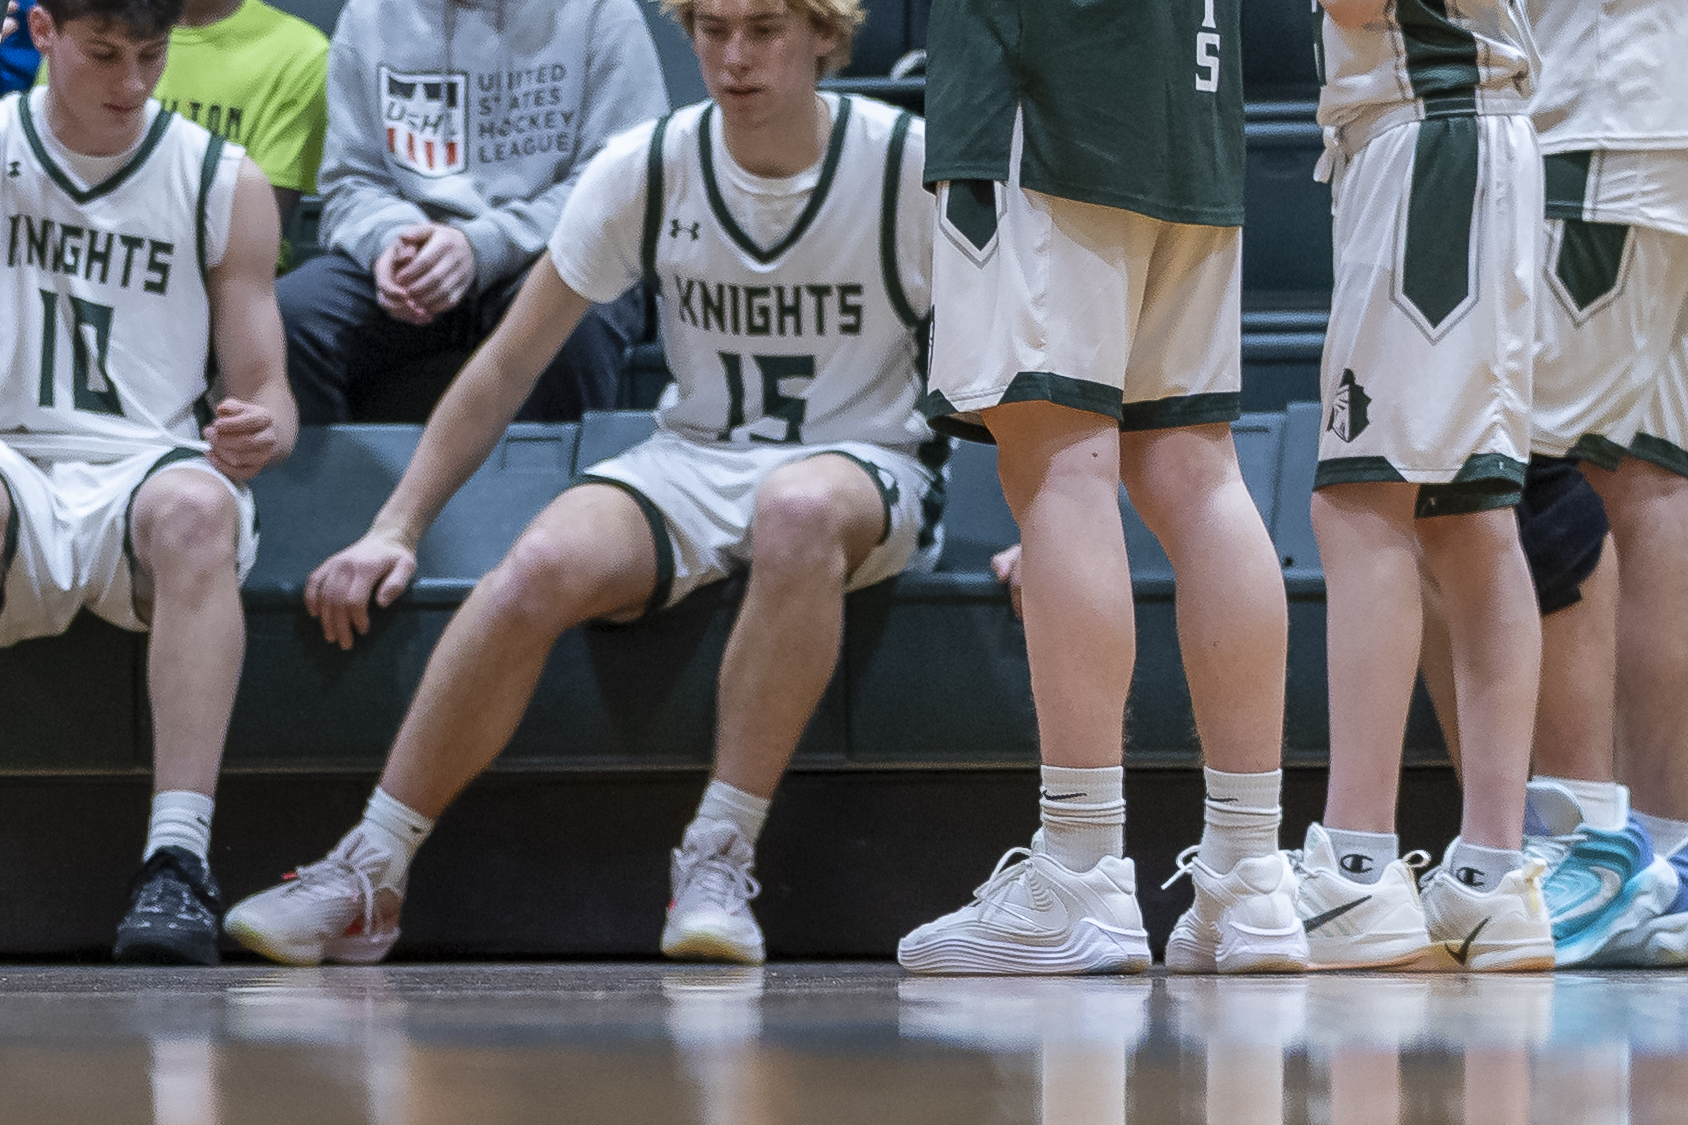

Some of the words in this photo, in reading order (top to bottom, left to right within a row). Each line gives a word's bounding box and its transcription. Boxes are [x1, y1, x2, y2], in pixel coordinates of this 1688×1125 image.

[477, 131, 571, 164] LEAGUE
[675, 273, 864, 337] KNIGHTS
[38, 289, 127, 418] 10
[716, 351, 816, 445] 15
